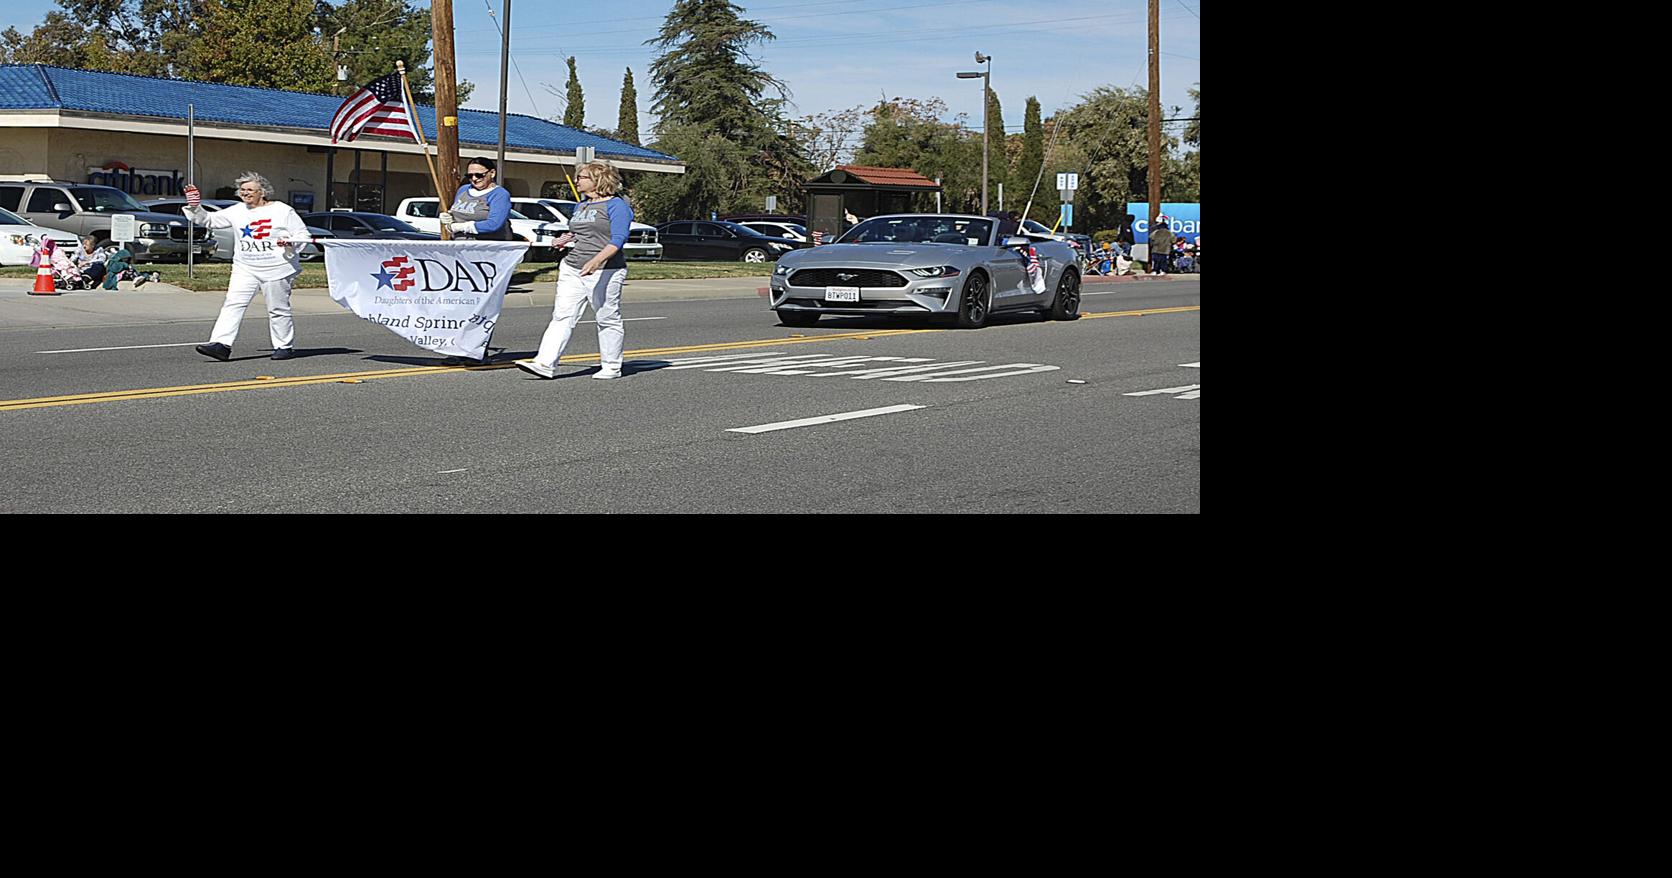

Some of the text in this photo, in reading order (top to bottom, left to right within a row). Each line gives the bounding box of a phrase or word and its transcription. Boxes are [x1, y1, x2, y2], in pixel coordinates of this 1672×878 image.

[240, 240, 274, 252] DAR
[374, 296, 412, 305] Daughters
[414, 296, 421, 305] of
[421, 296, 434, 305] the
[436, 296, 475, 305] American
